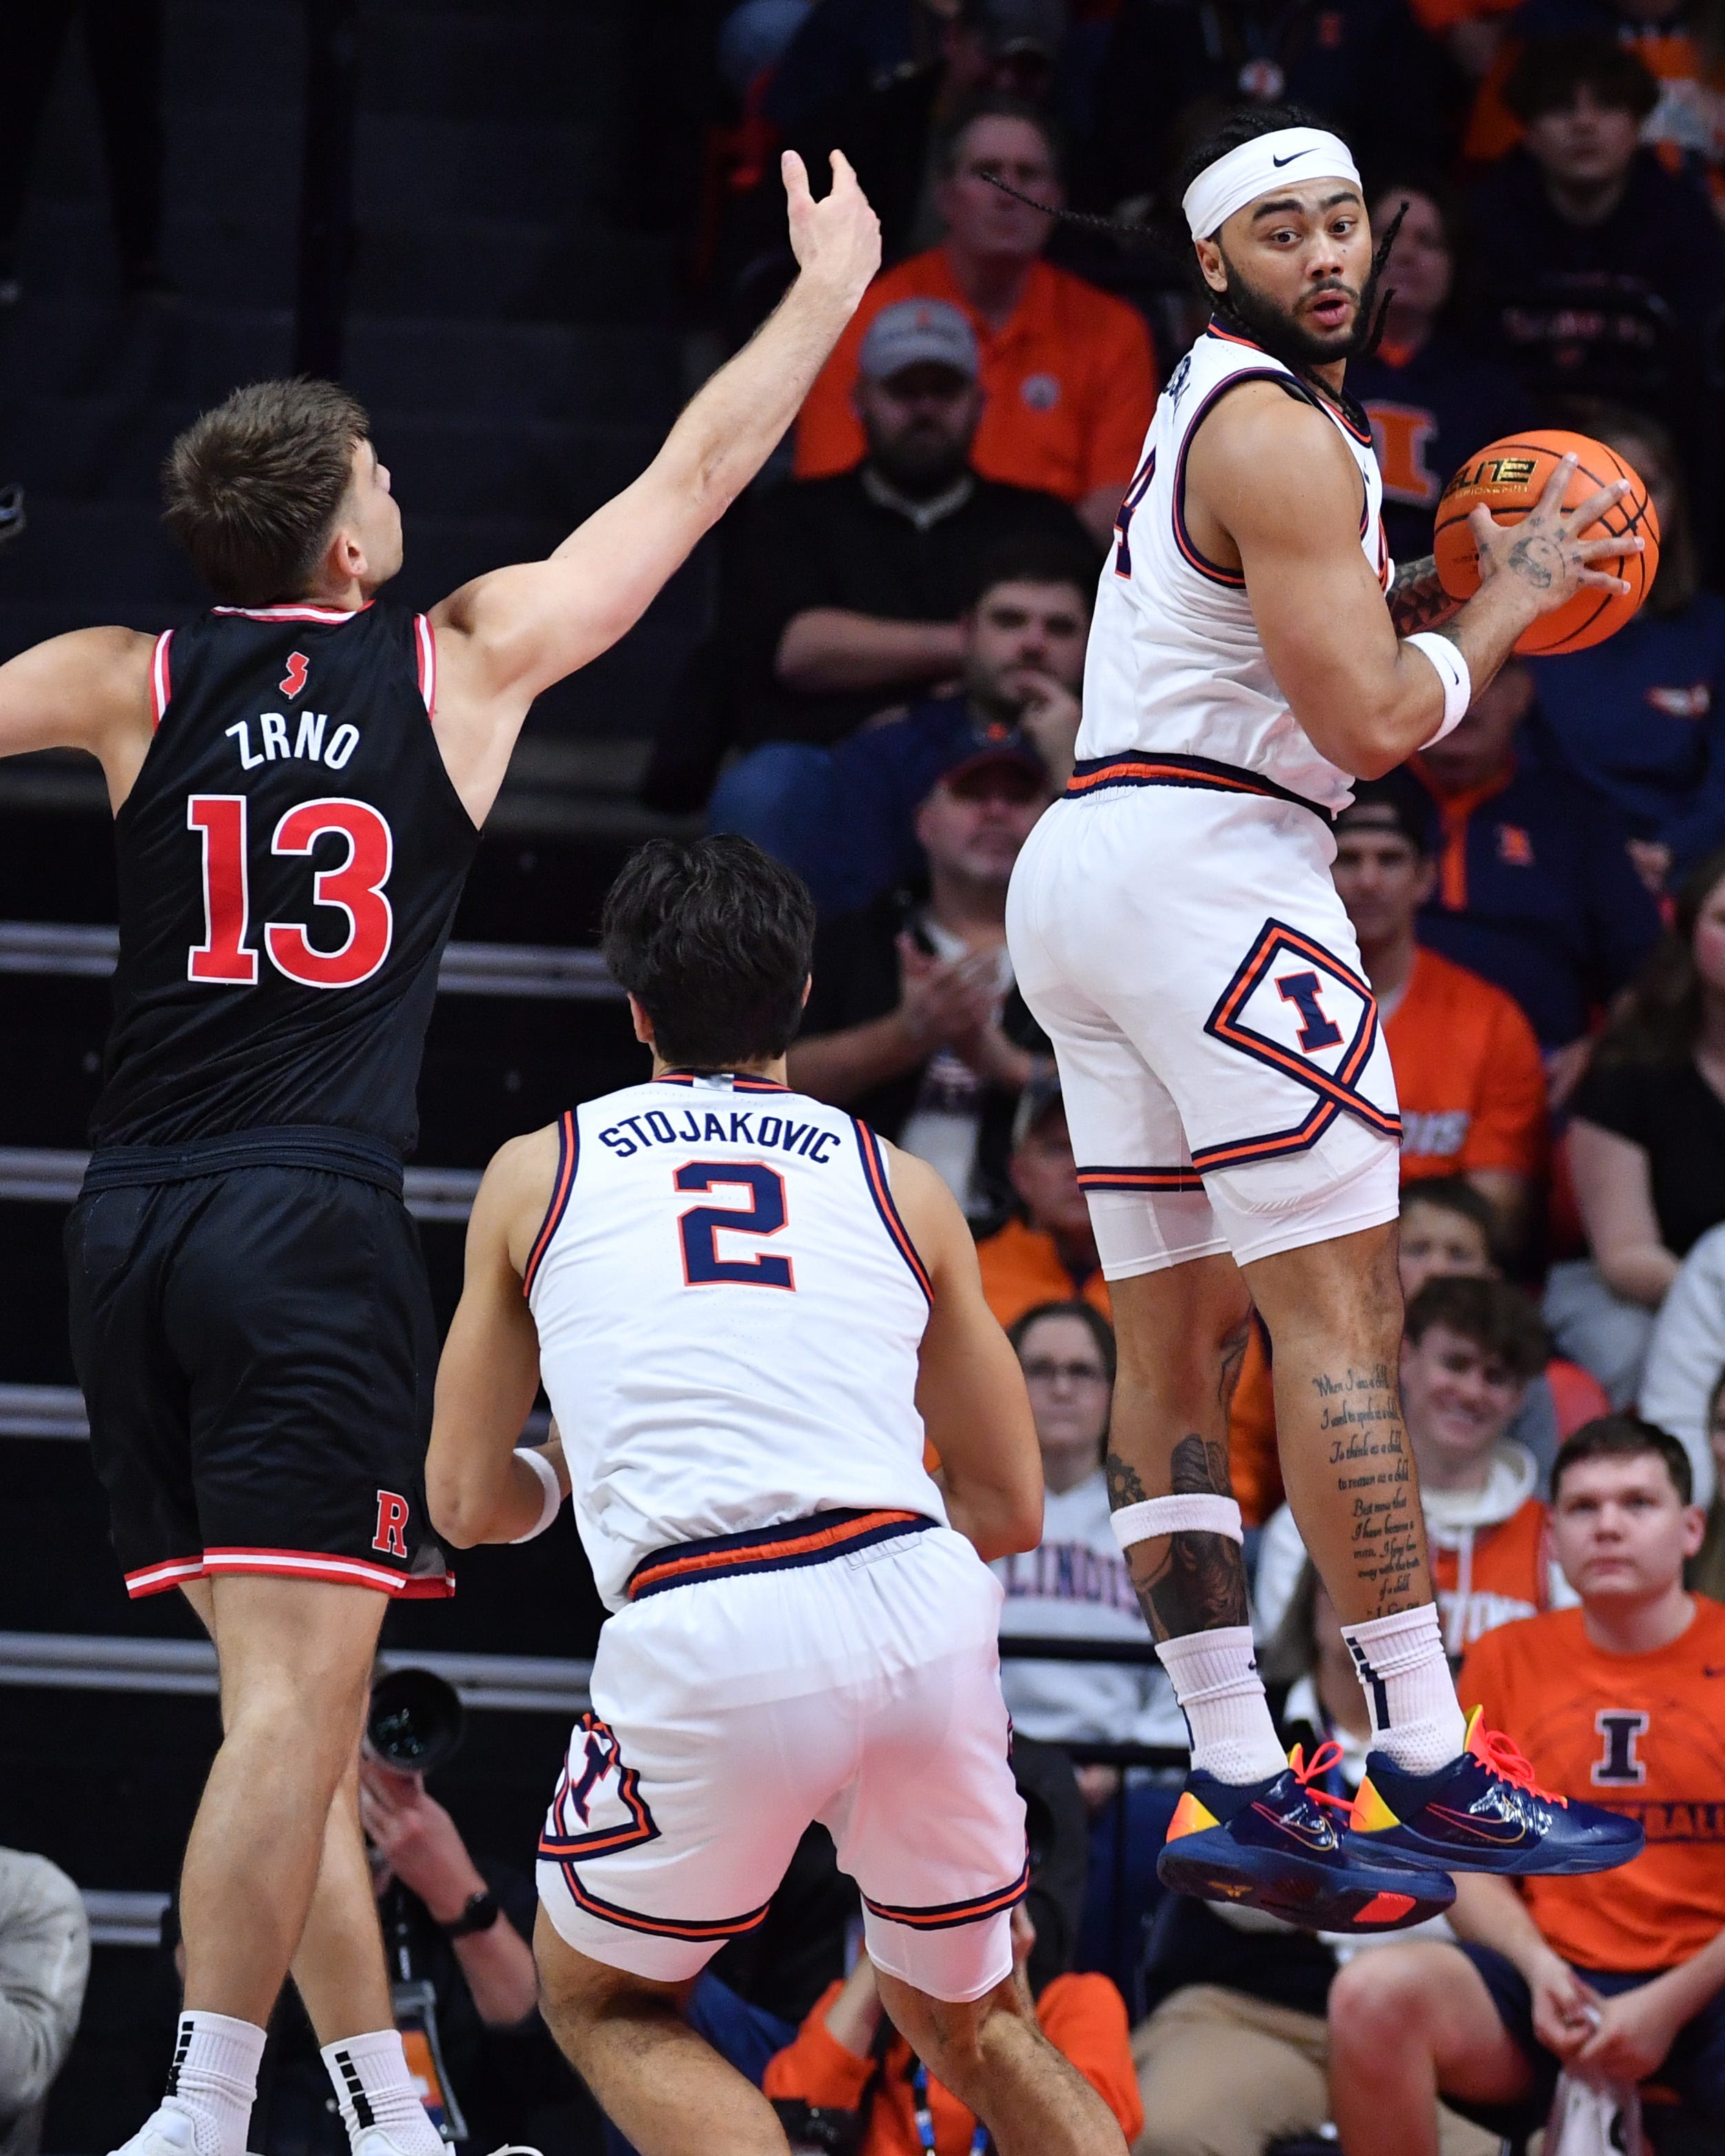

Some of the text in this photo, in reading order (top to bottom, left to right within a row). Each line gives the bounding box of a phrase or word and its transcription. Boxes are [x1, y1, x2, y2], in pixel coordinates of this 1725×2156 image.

[226, 711, 360, 770] ZRNO
[187, 794, 393, 989] 13
[1274, 970, 1344, 1054] I
[598, 1110, 842, 1164] STOJAKOVIC
[672, 1160, 796, 1293] 2
[1312, 1373, 1343, 1397] When
[1348, 1476, 1375, 1488] reason
[372, 1489, 409, 1559] R
[1591, 1709, 1649, 1787] I
